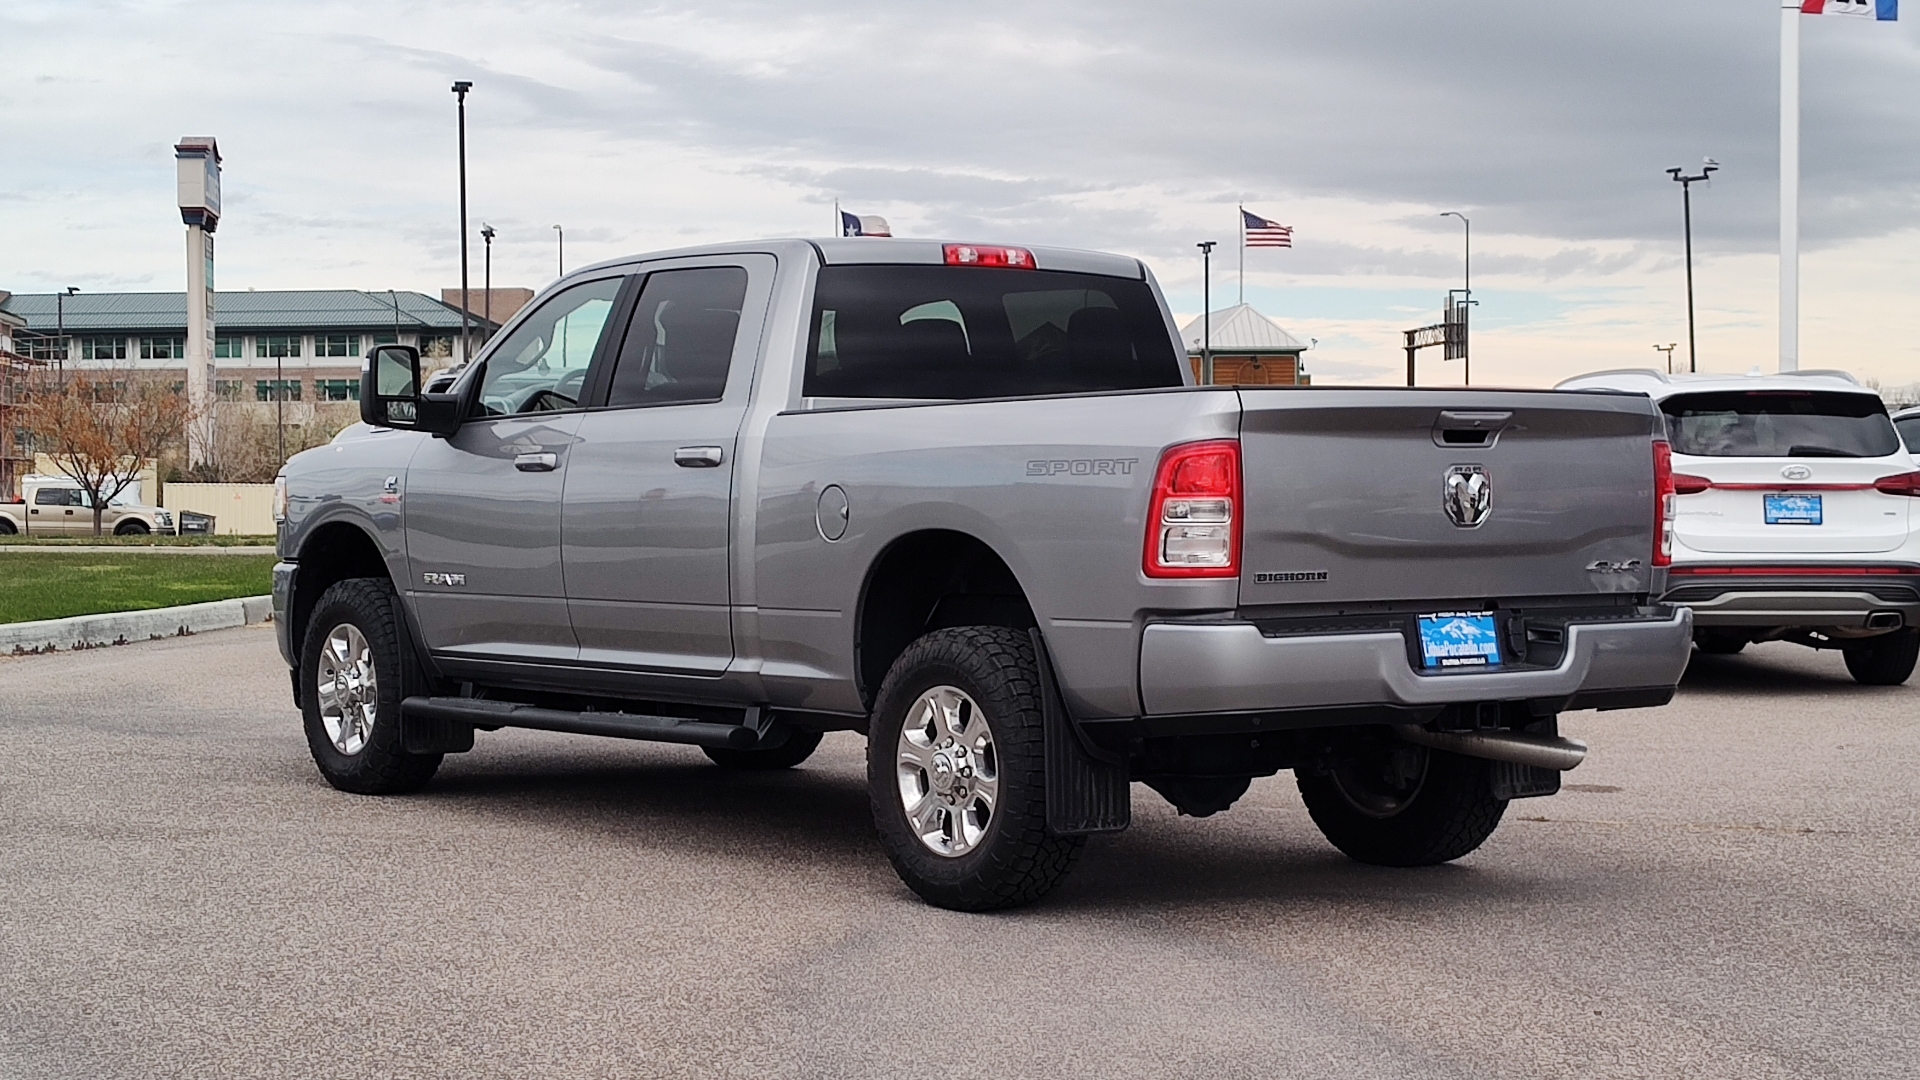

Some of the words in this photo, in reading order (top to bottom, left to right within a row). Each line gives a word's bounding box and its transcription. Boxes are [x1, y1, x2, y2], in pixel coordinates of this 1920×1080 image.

[1026, 458, 1139, 476] SPORT
[422, 571, 466, 586] RAM
[1255, 571, 1328, 582] BIGHORN
